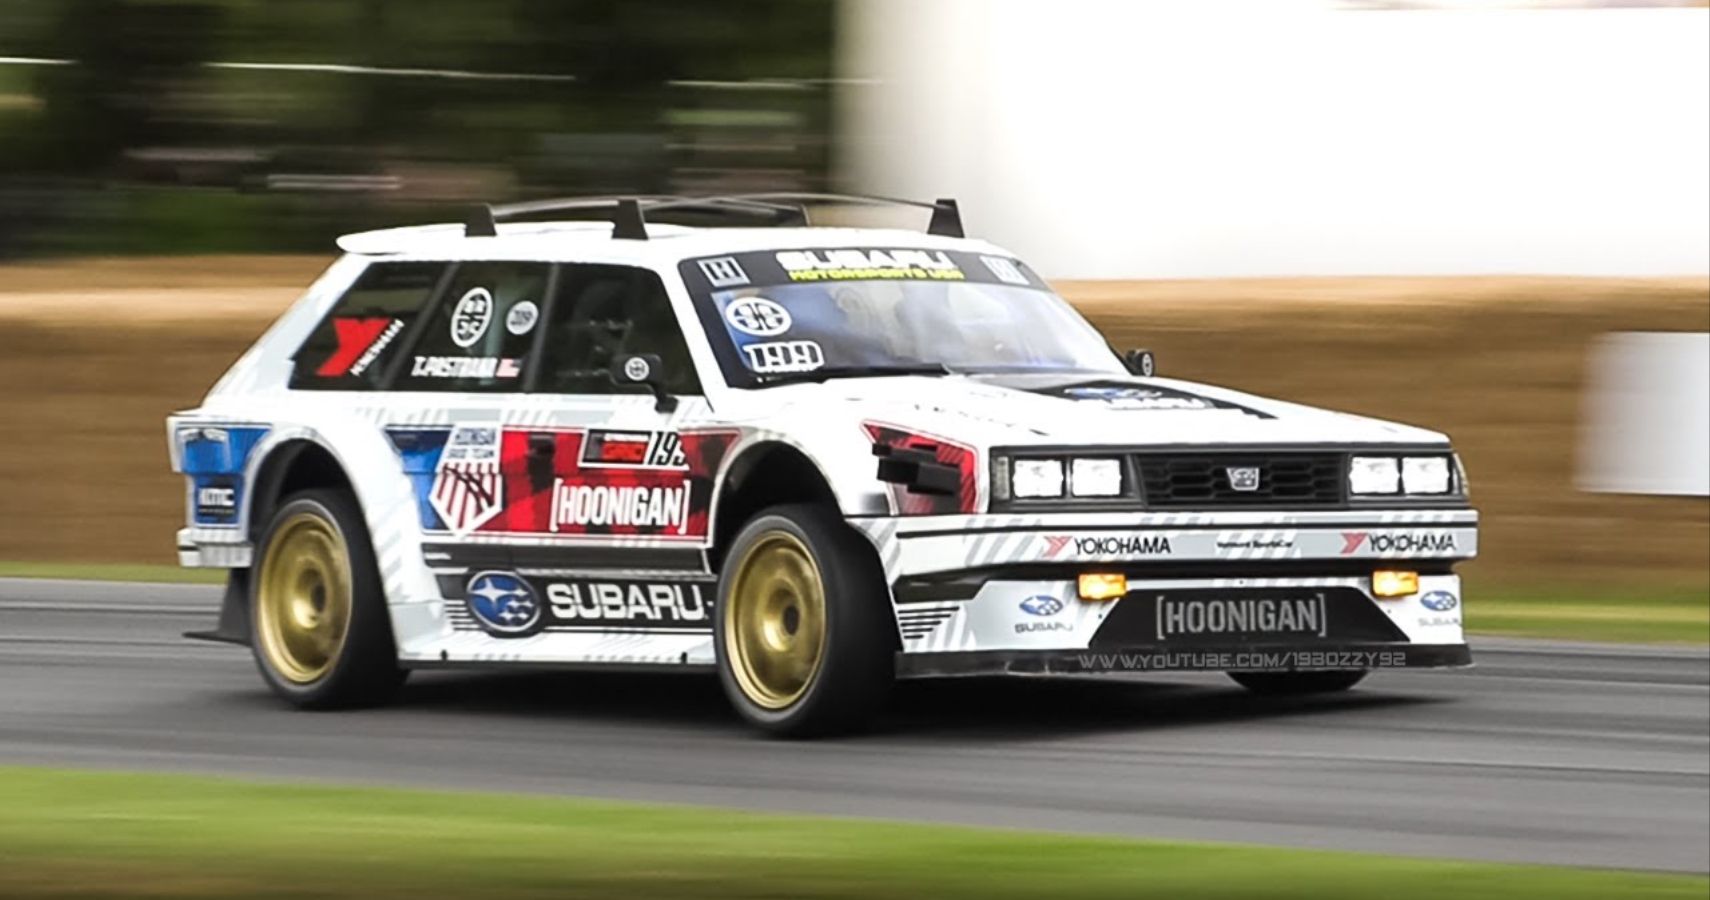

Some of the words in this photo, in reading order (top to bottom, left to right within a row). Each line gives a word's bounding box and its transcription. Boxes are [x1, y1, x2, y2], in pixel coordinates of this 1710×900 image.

[742, 341, 824, 373] 199
[1074, 537, 1172, 555] YOKOHAMA
[1369, 534, 1456, 552] YOKOHAMA
[546, 583, 706, 620] SUBARU
[1015, 622, 1073, 634] SUBARU
